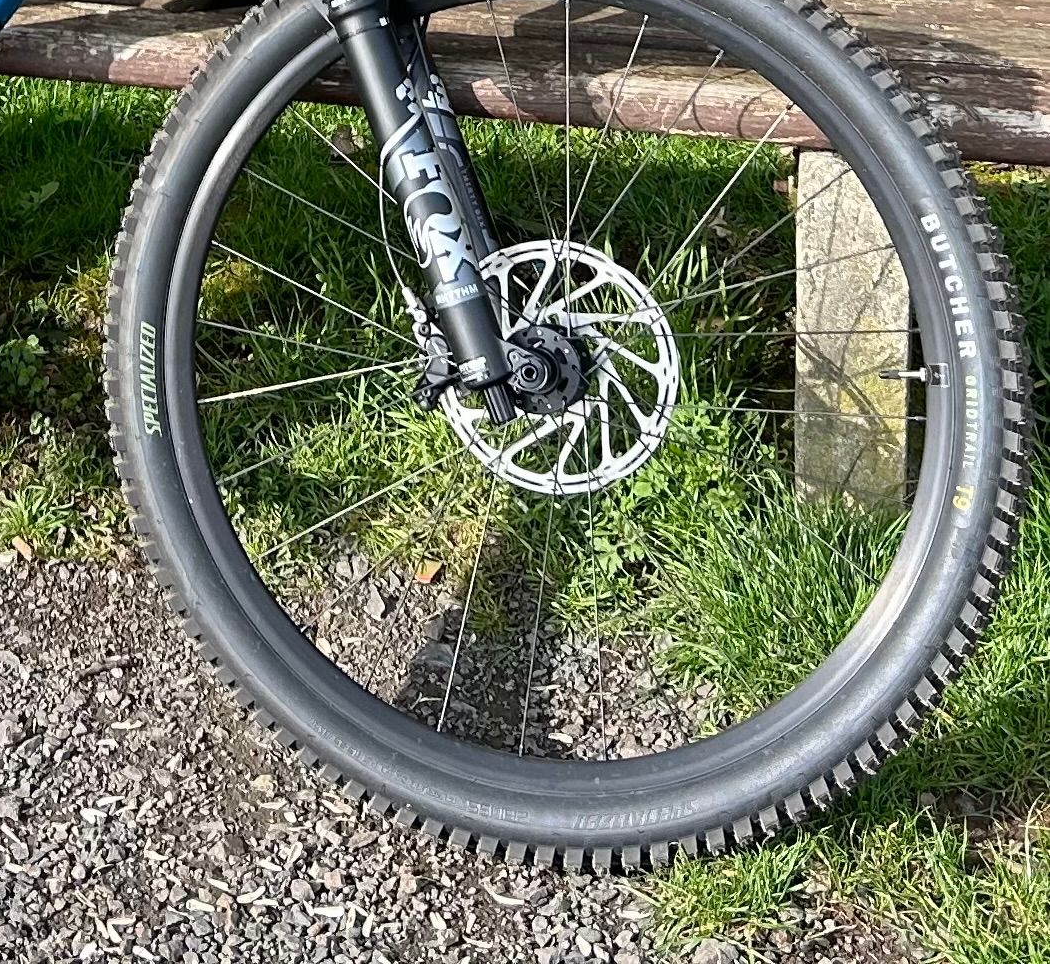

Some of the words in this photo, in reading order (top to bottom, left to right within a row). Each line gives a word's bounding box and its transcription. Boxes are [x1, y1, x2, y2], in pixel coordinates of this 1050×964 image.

[401, 145, 480, 284] FOX
[140, 321, 162, 437] SPECIALIZED
[920, 212, 977, 358] BUTCHER
[952, 485, 975, 511] T9
